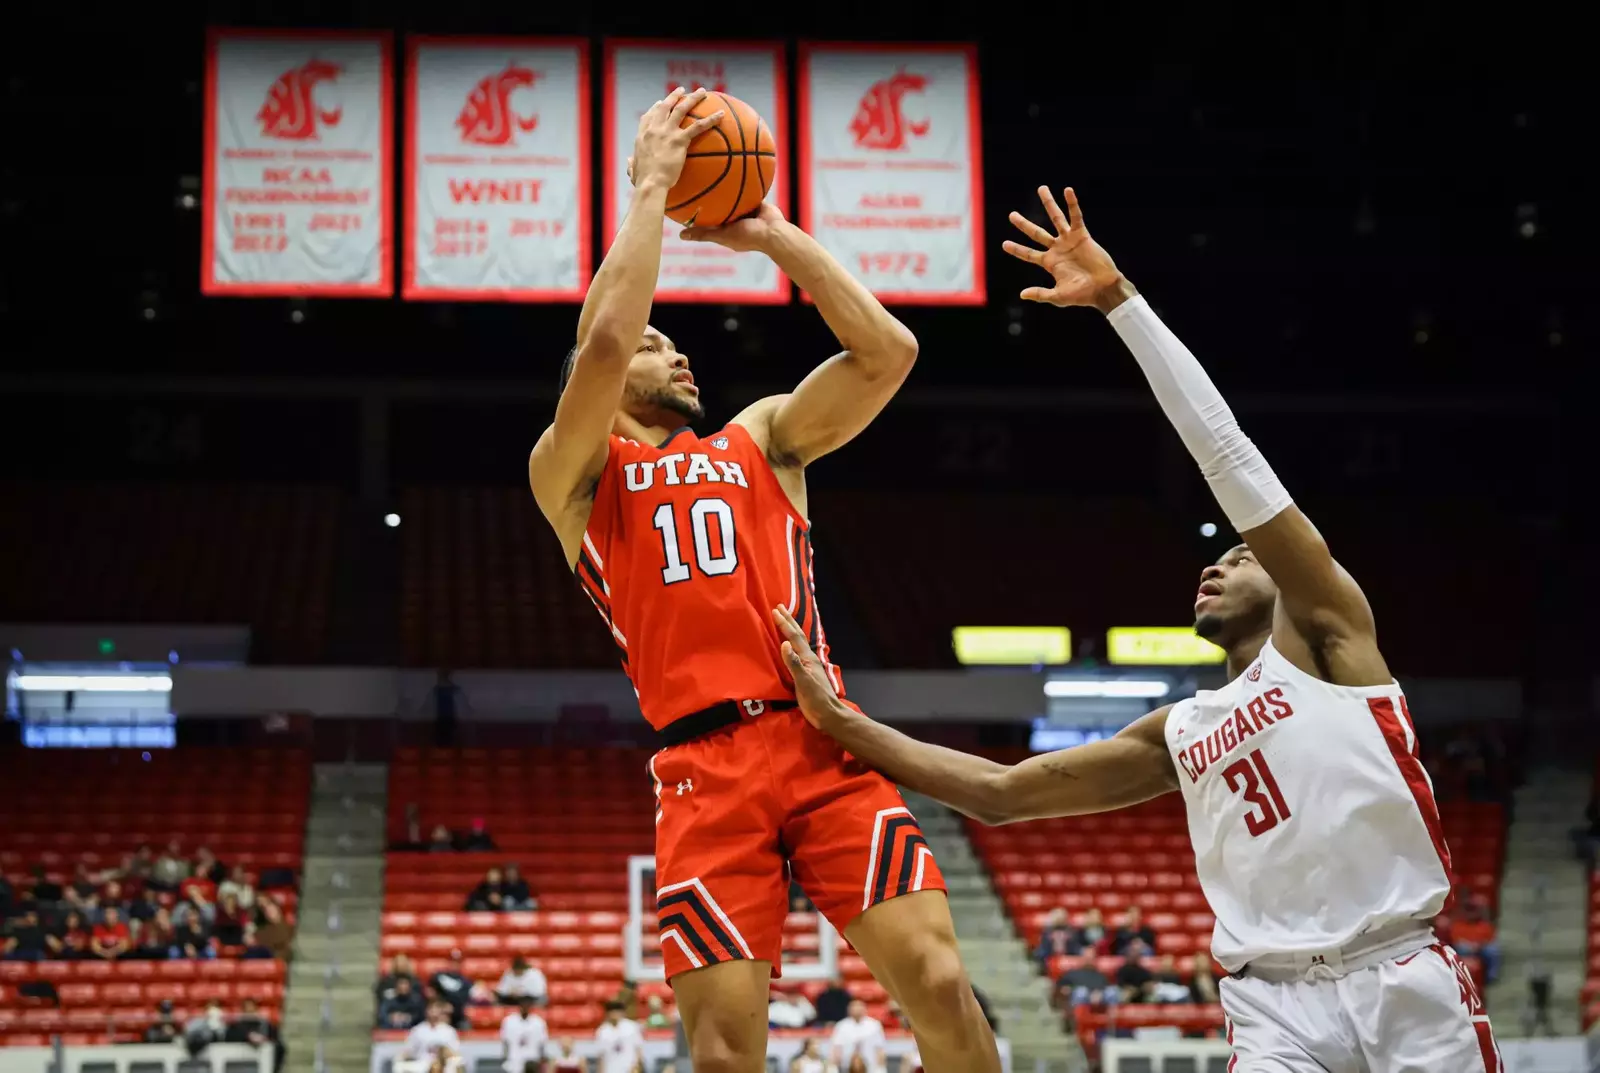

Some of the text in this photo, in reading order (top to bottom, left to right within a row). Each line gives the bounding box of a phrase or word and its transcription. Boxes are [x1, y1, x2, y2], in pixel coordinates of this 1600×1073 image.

[448, 177, 543, 204] WNIT
[858, 253, 928, 276] 1972
[623, 452, 749, 492] UTAH
[652, 497, 739, 586] 10
[1177, 687, 1294, 784] COUGARS
[1221, 748, 1292, 837] 31
